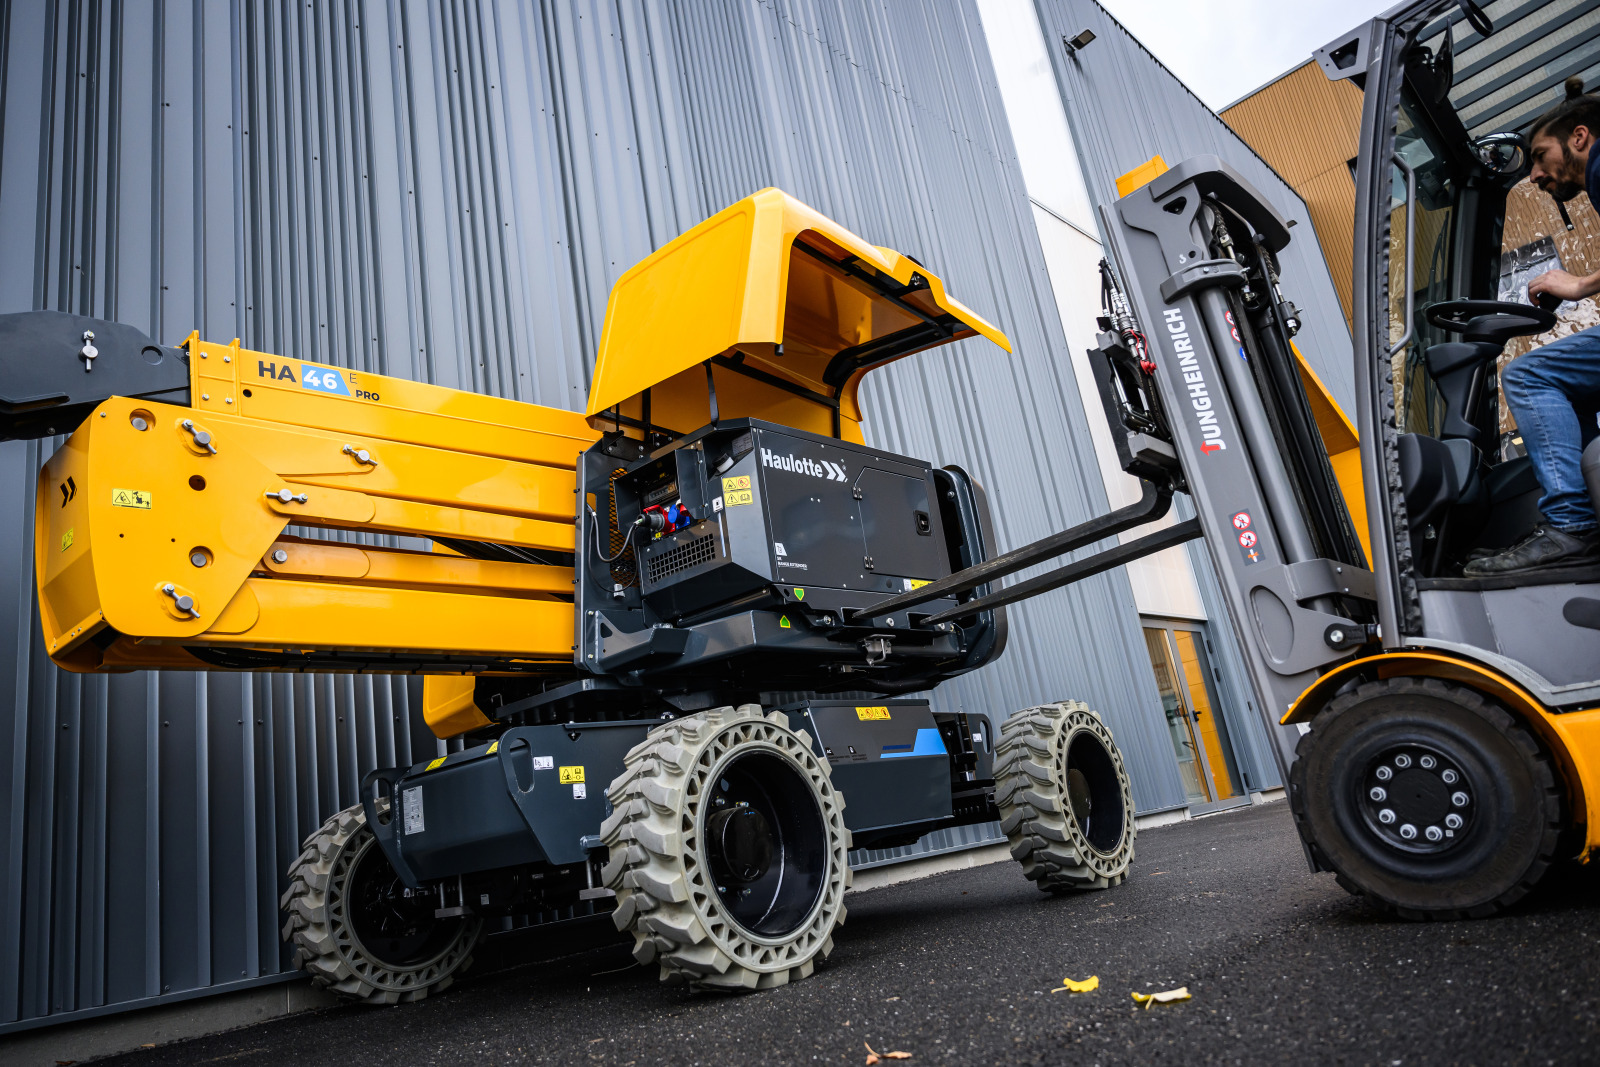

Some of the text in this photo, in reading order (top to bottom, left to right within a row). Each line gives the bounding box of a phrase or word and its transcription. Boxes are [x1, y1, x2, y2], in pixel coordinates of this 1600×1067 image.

[258, 360, 381, 402] HA 46 E PRO
[1162, 307, 1227, 456] JUNGHEINRICH
[760, 447, 824, 478] Haulotte
